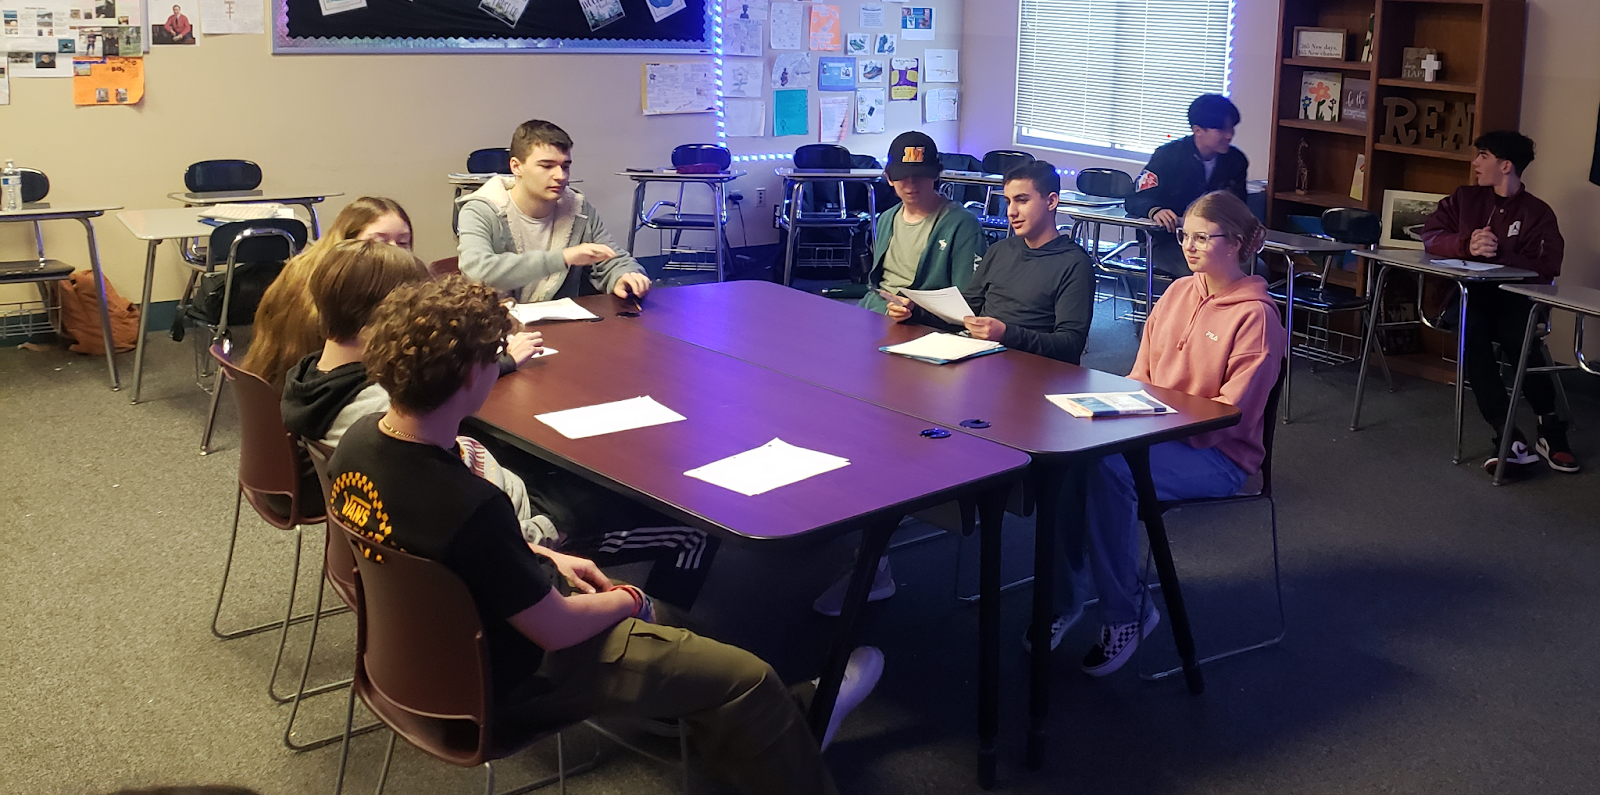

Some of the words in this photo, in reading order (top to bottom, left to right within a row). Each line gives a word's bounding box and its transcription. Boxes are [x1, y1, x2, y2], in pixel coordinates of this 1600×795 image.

[1403, 69, 1425, 78] HAP
[902, 146, 925, 163] M
[1205, 330, 1218, 342] FILA
[342, 491, 372, 527] VANS
